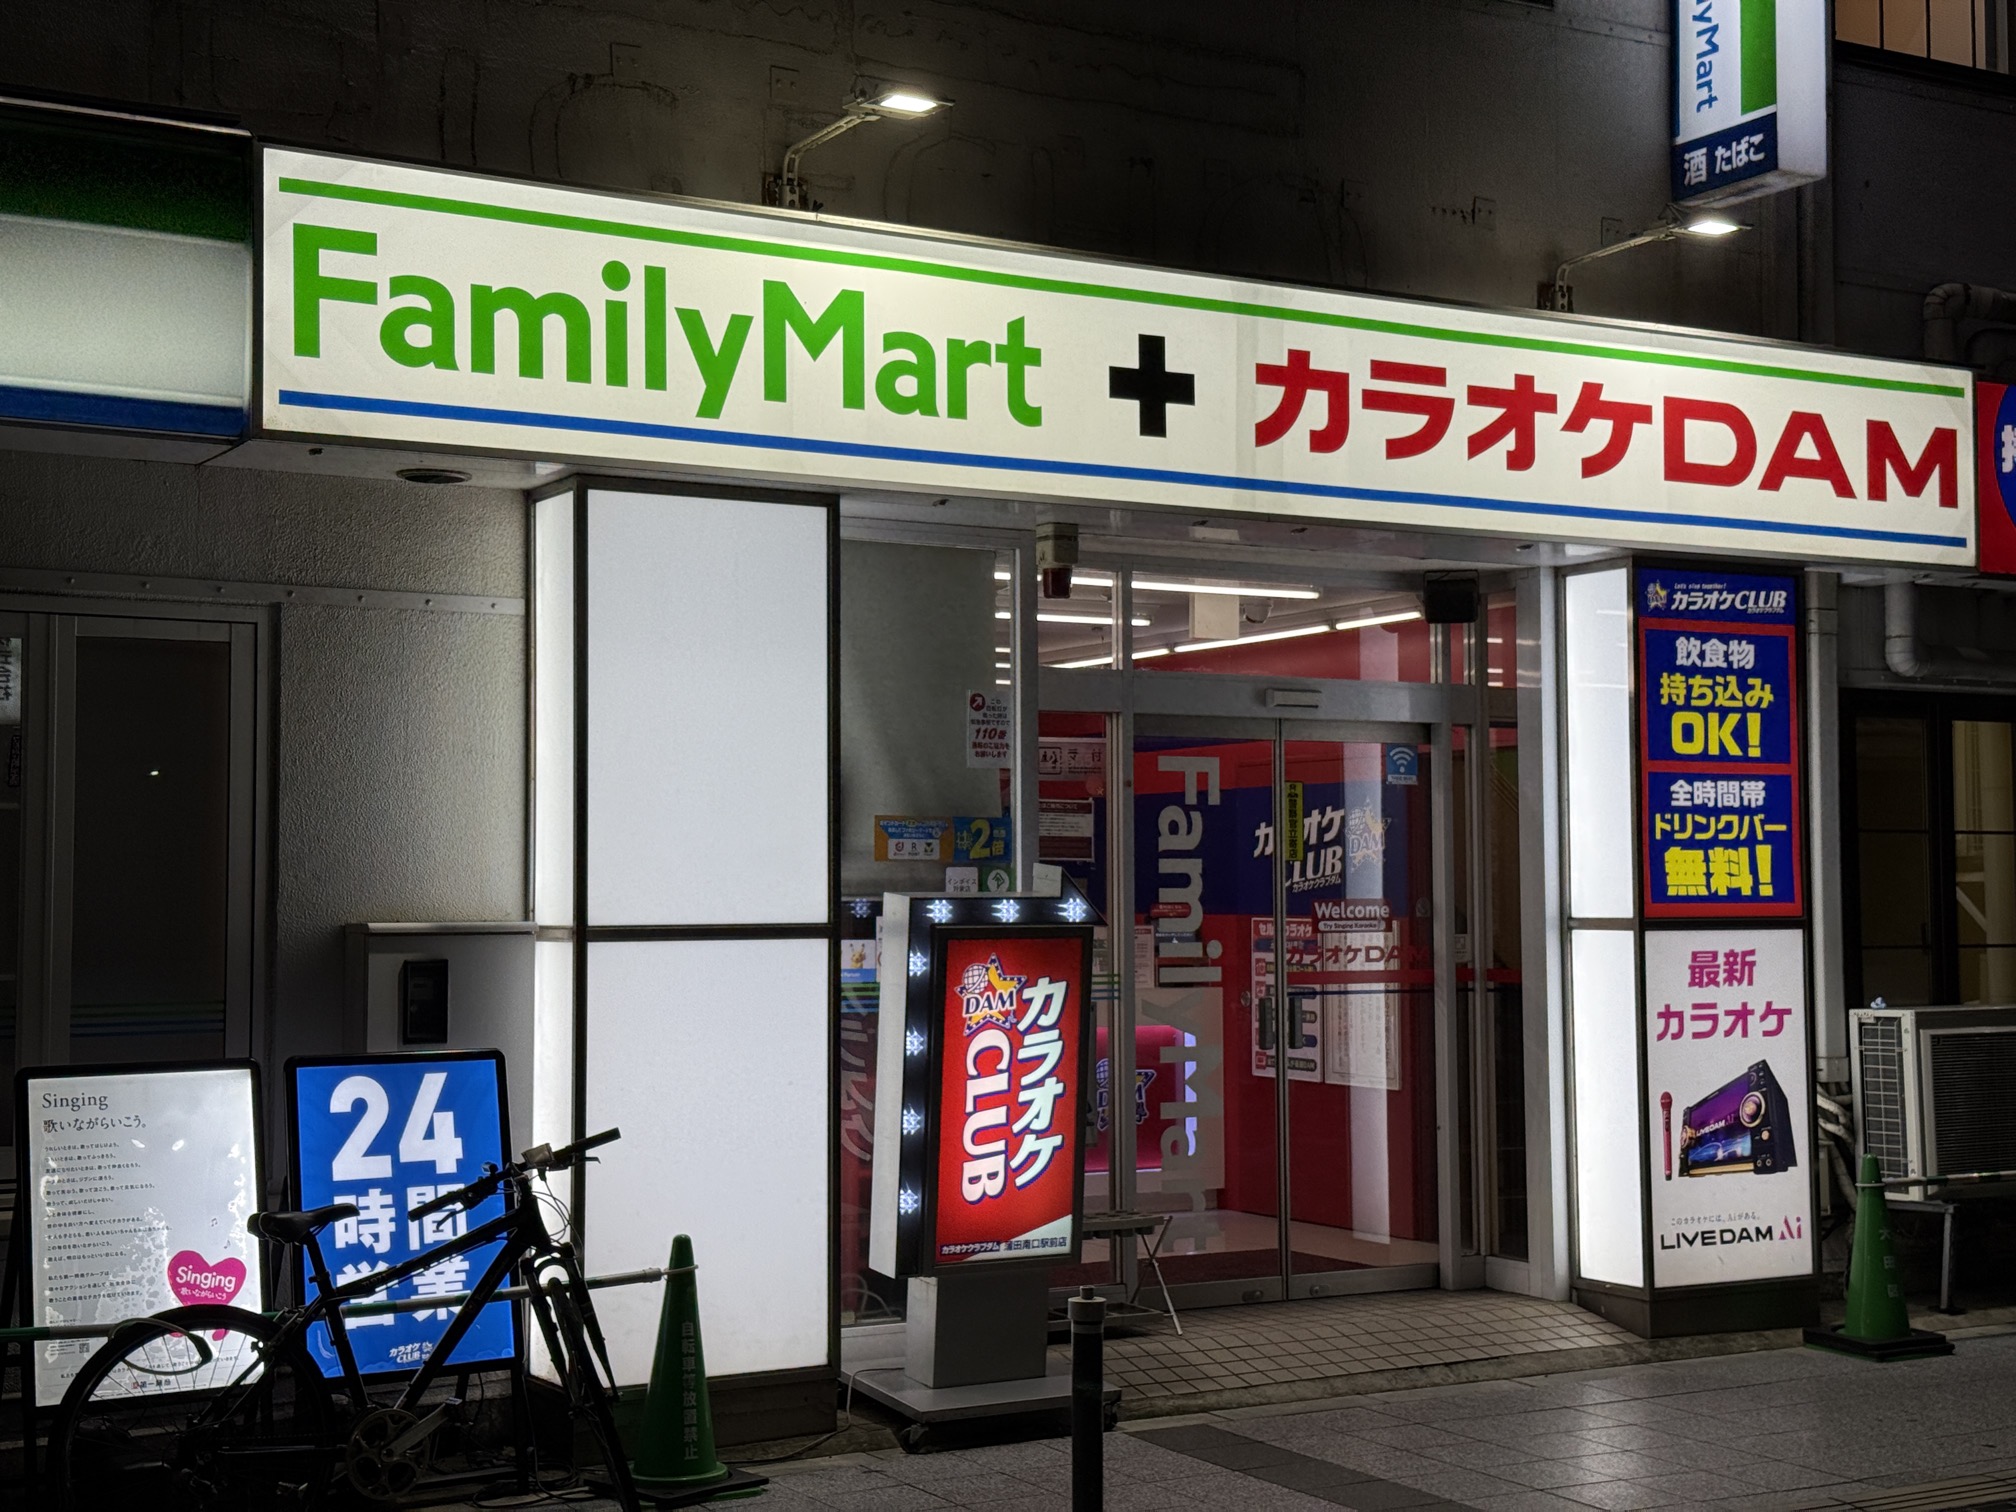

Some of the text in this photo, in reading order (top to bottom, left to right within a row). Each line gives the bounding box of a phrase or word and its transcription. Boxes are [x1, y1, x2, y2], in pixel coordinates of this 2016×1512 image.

[1692, 0, 1720, 113] yMart
[1684, 133, 1765, 187] 酒 たばこ
[292, 222, 1043, 427] FamilyMart
[1255, 349, 1958, 508] カラオケDAM
[1671, 590, 1787, 610] カラオケCLUB
[1675, 637, 1755, 669] 飲食物
[1660, 672, 1774, 708] 持ち込み
[975, 727, 1007, 740] 110番
[1671, 711, 1761, 757] OK!
[1670, 780, 1766, 808] 全時間帯
[1655, 813, 1787, 841] ドリンクバー
[1285, 846, 1343, 886] LUB
[1665, 844, 1773, 896] 無料!
[1314, 902, 1390, 919] Welcome
[1688, 949, 1756, 988] 最新
[964, 989, 1016, 1018] DAM
[1141, 755, 1223, 1252] FamilyMart
[1657, 1001, 1792, 1042] カラオケ
[1010, 976, 1068, 1189] カラオケ
[42, 1092, 109, 1112] Singing
[961, 1028, 1012, 1204] CLUB
[43, 1114, 147, 1134] 歌いながらいこう。
[329, 1072, 463, 1182] 24
[334, 1183, 467, 1254] 時間
[941, 1242, 1000, 1255] カラオケクラブダム
[1661, 1225, 1773, 1250] LIVEDAM
[175, 1265, 237, 1293] Singing
[389, 1342, 421, 1358] カラオケ
